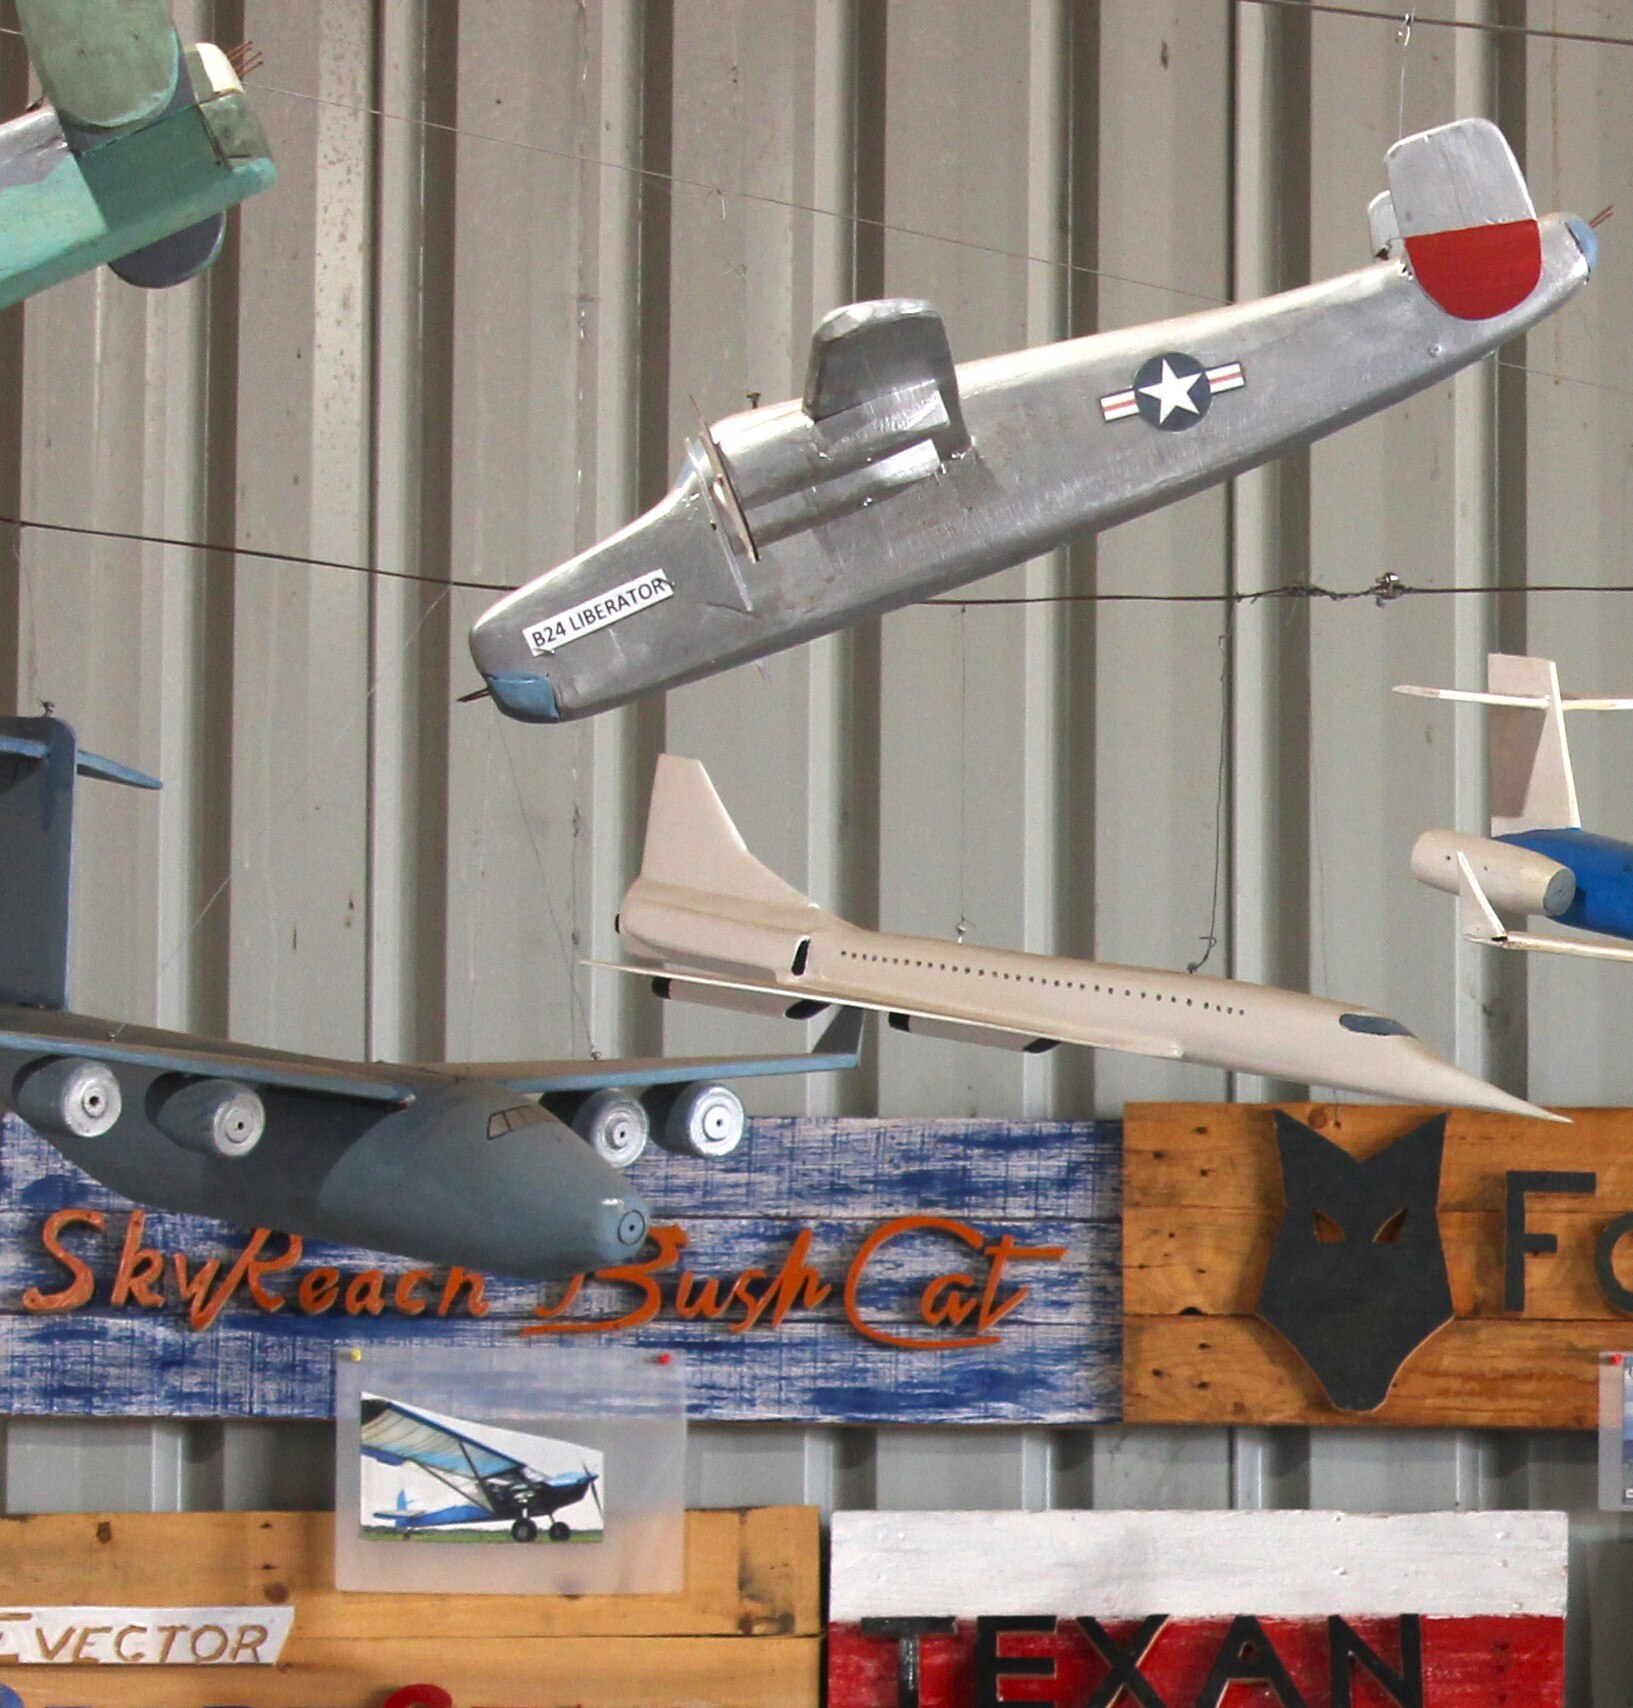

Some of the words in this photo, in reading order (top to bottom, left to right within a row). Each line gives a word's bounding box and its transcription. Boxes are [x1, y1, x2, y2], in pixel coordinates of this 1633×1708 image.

[532, 622, 567, 648] B24
[569, 578, 666, 632] LIBERATOR
[518, 1224, 832, 1336] Bush
[844, 1215, 1068, 1349] Cat
